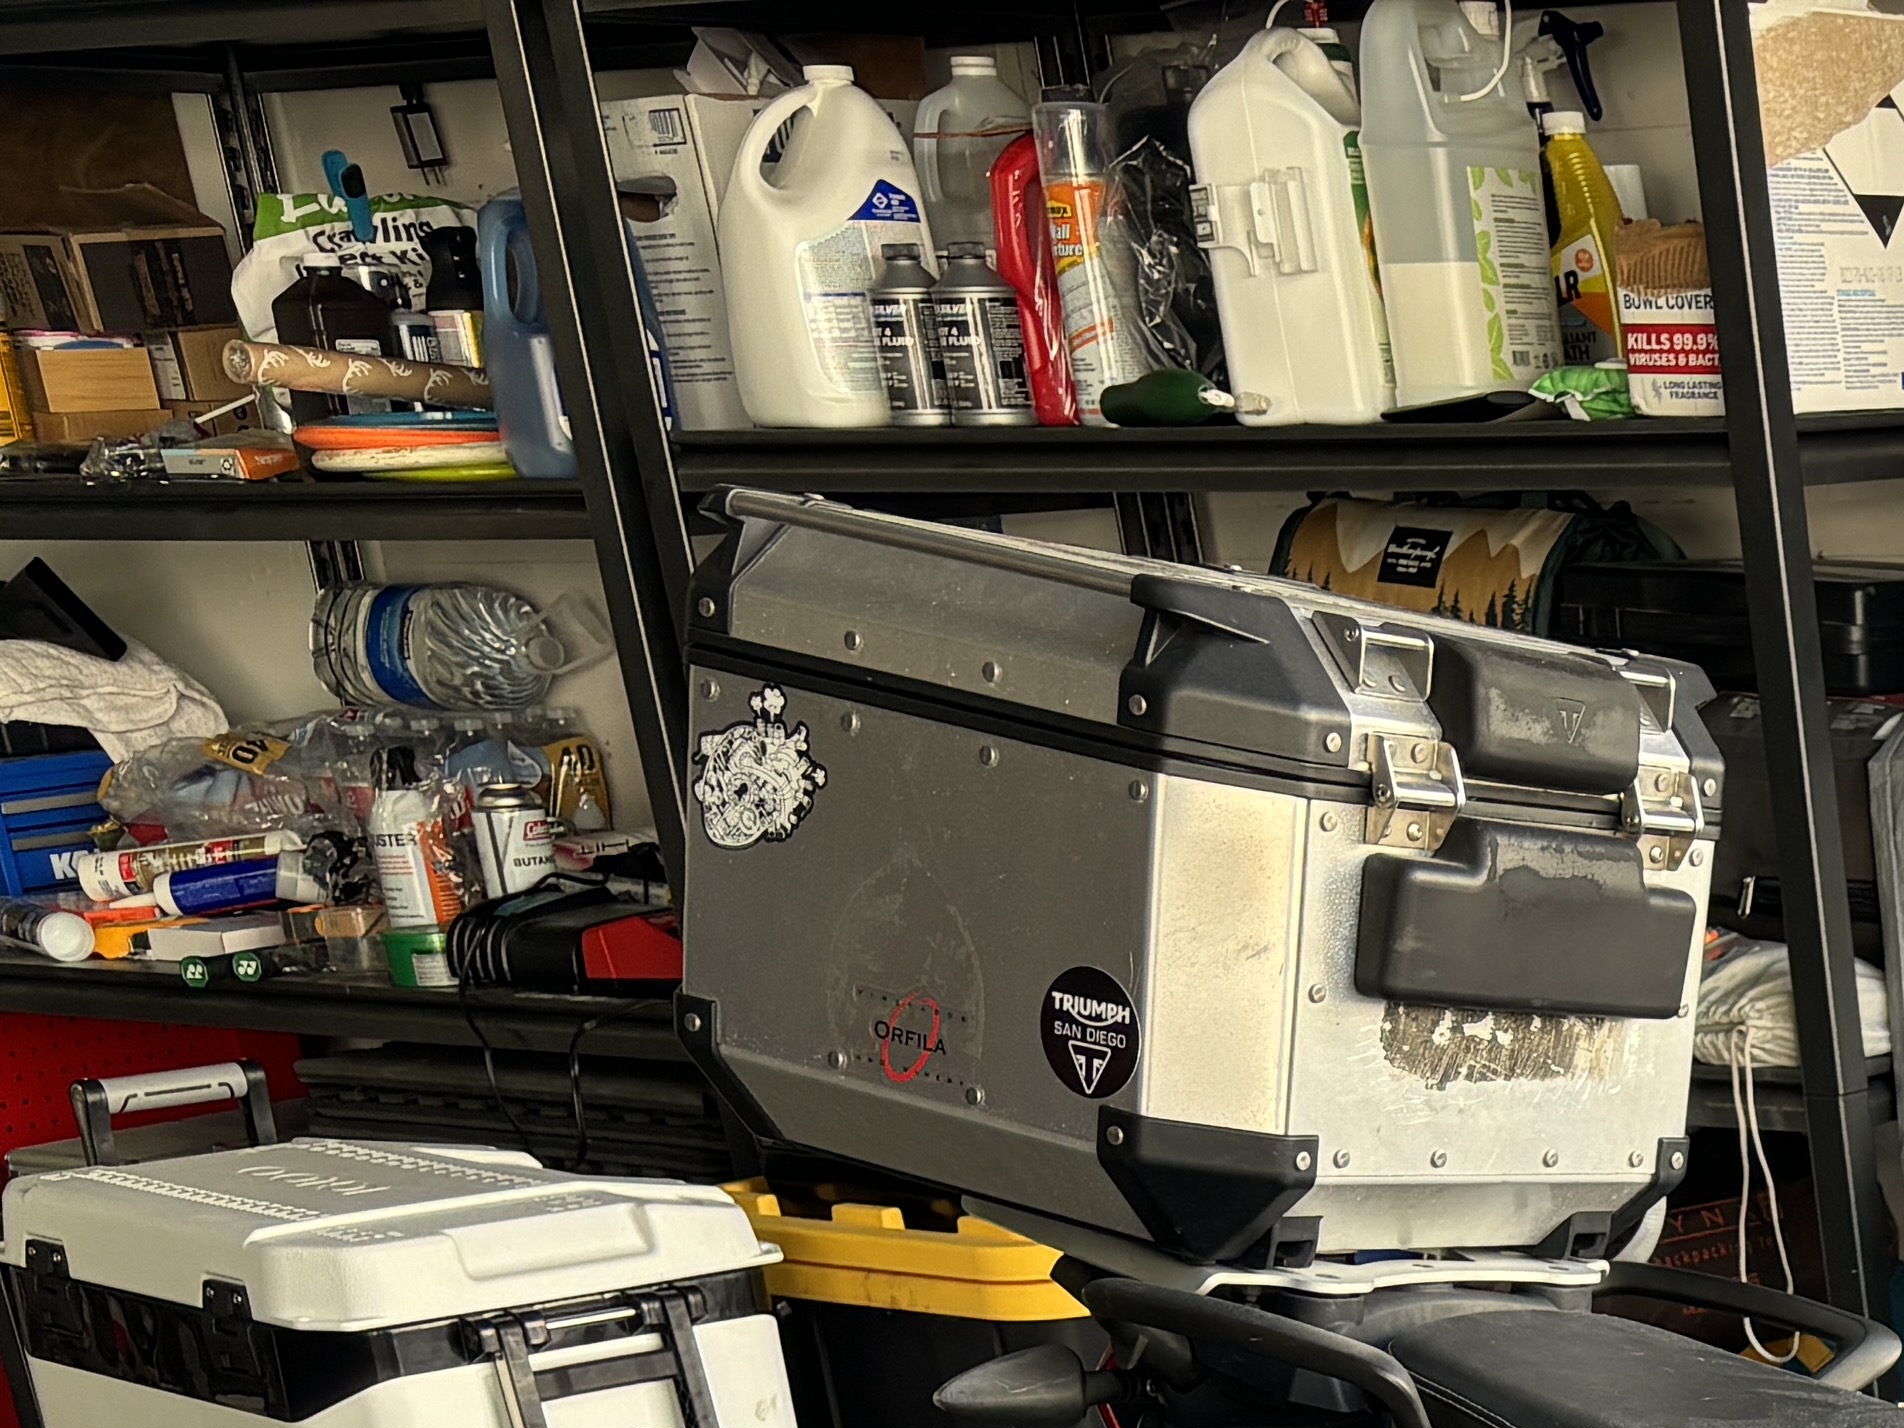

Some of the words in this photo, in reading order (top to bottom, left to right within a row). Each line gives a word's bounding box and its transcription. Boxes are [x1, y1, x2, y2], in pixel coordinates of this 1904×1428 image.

[1627, 332, 1671, 350] KILLS
[1628, 352, 1676, 367] VIRUSES
[1663, 380, 1686, 391] LONG
[1051, 991, 1130, 1027] TRIUMPH
[874, 1019, 947, 1056] ORFILA
[1053, 1020, 1082, 1040] SAN
[1086, 1027, 1127, 1049] DIEGO
